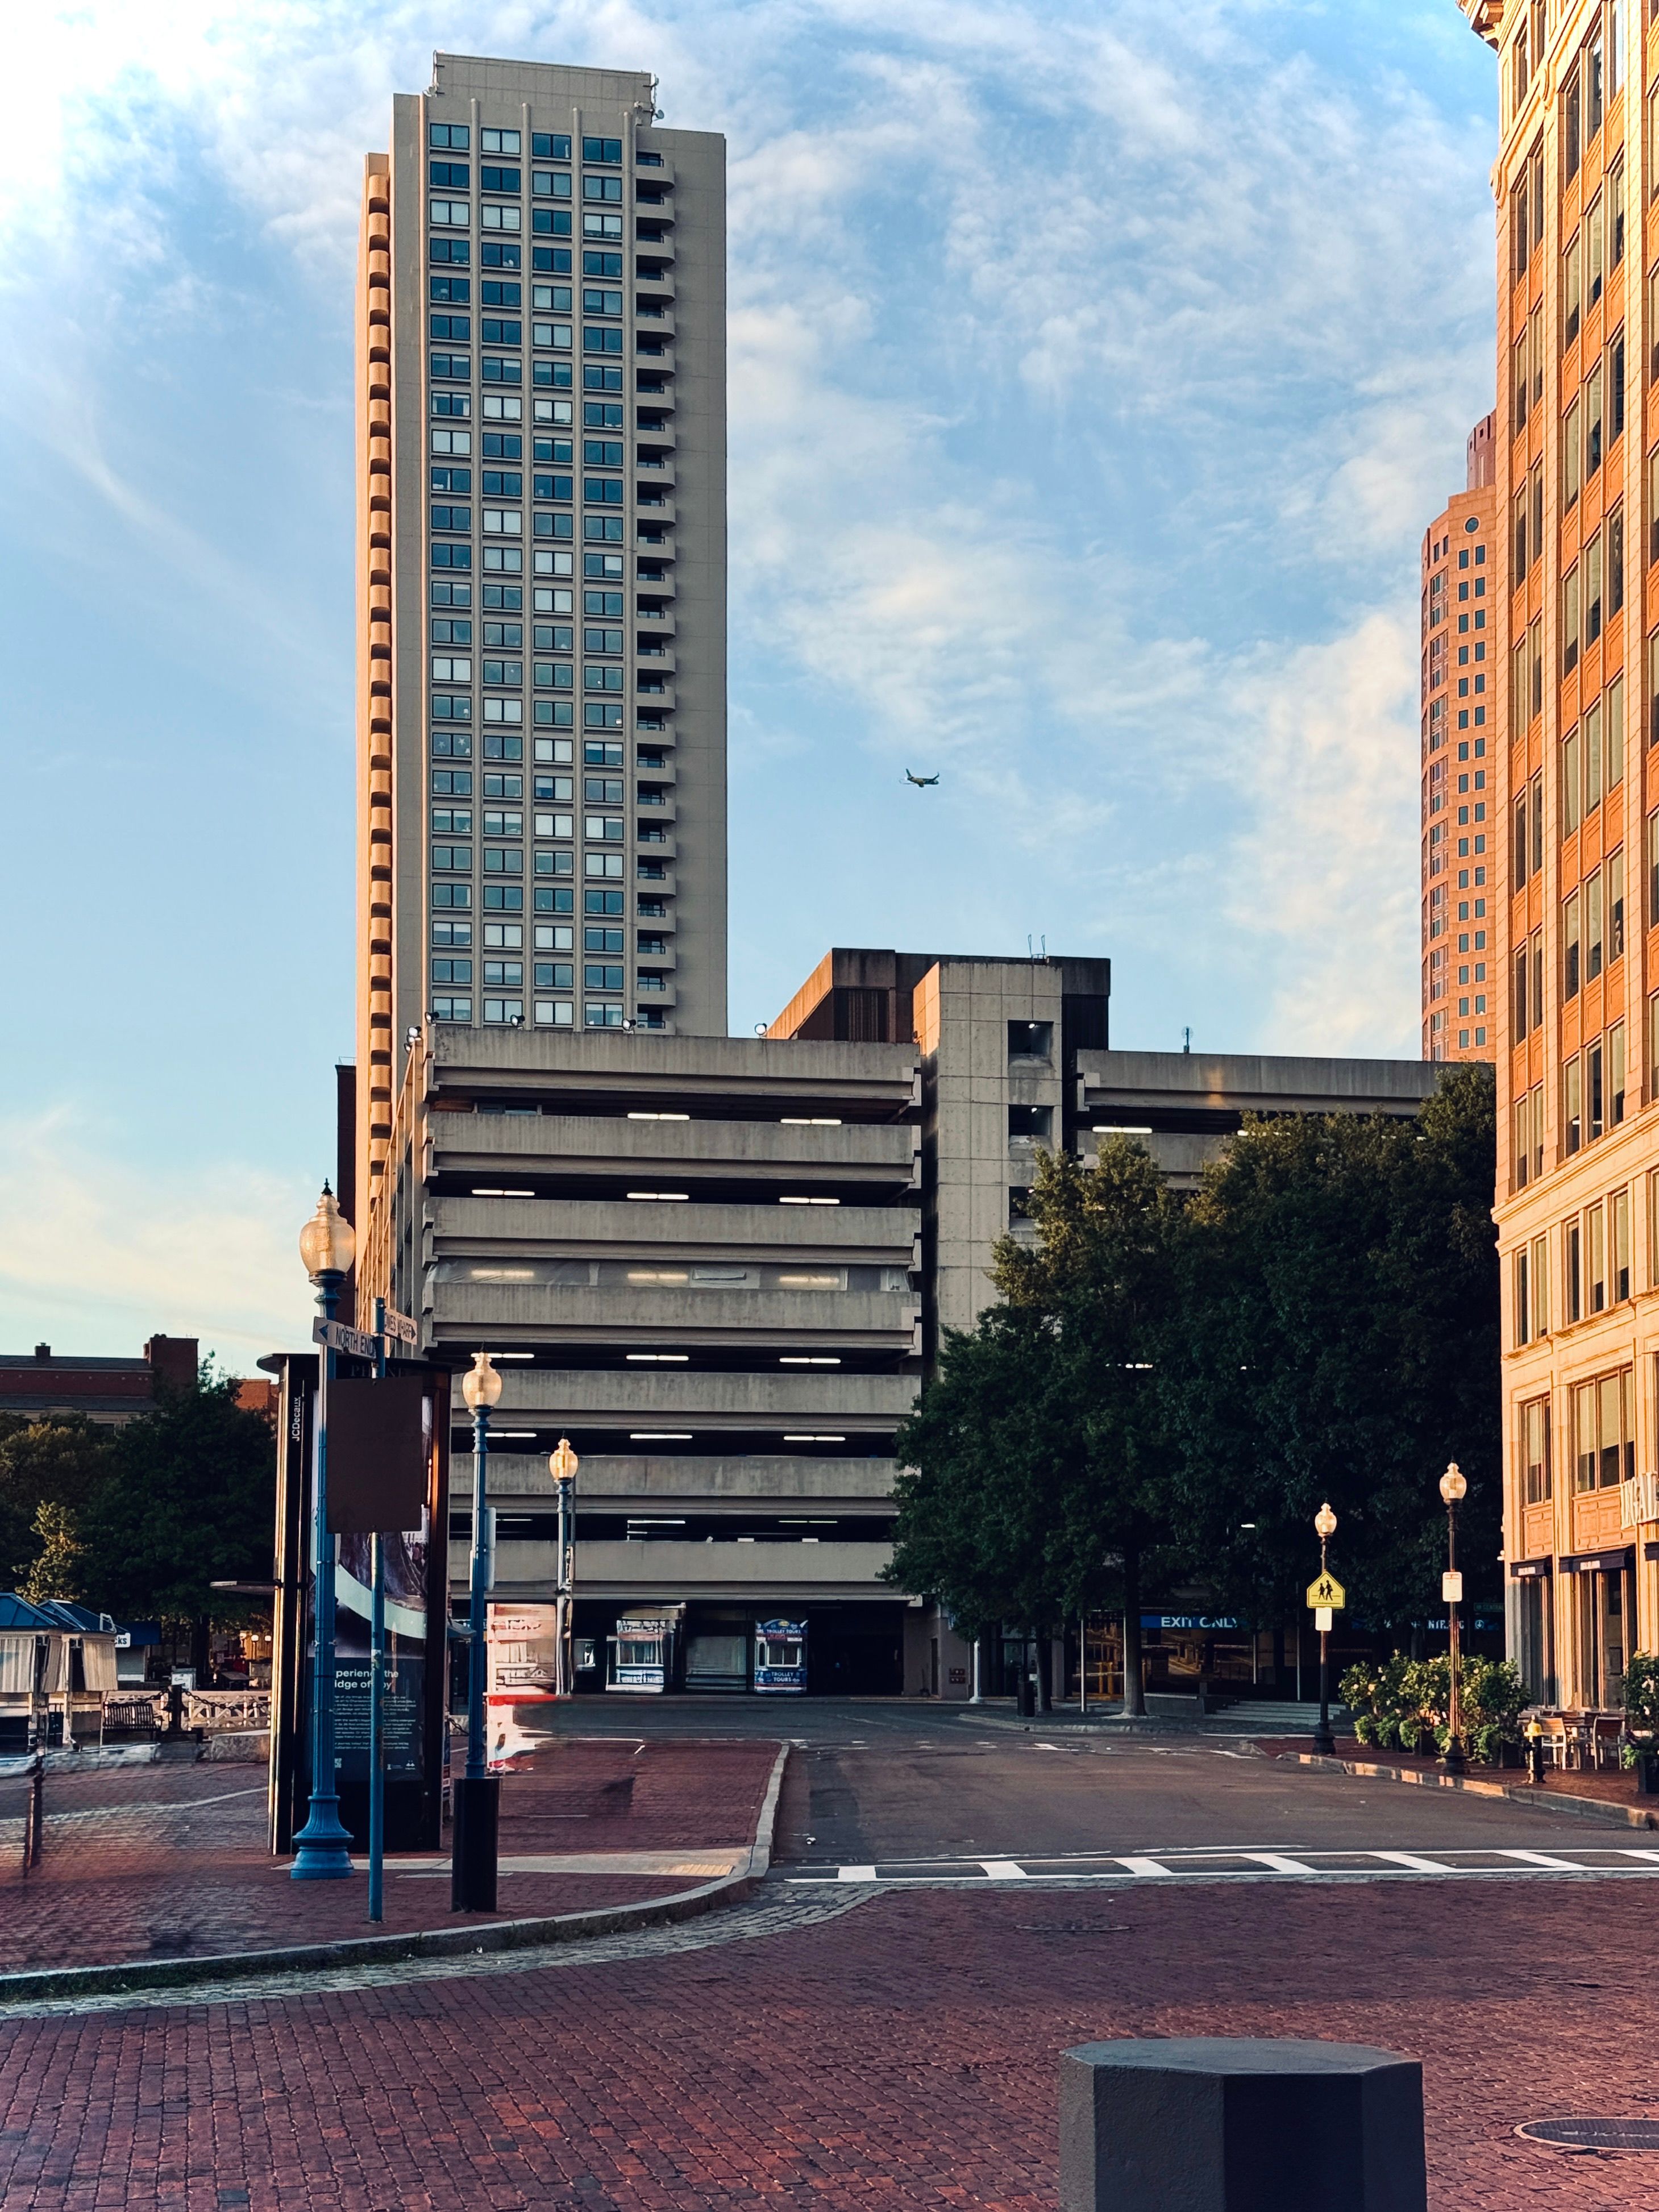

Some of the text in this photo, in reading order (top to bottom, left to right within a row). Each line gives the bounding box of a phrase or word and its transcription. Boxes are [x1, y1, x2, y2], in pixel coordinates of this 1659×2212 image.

[336, 1326, 377, 1361] NORTH END
[350, 1364, 403, 1378] PHNE
[291, 1396, 301, 1442] JCDecaux
[1619, 1471, 1657, 1531] LEGAL
[1161, 1616, 1193, 1628] EXIT
[114, 1637, 127, 1645] cks
[334, 1679, 357, 1690] idge
